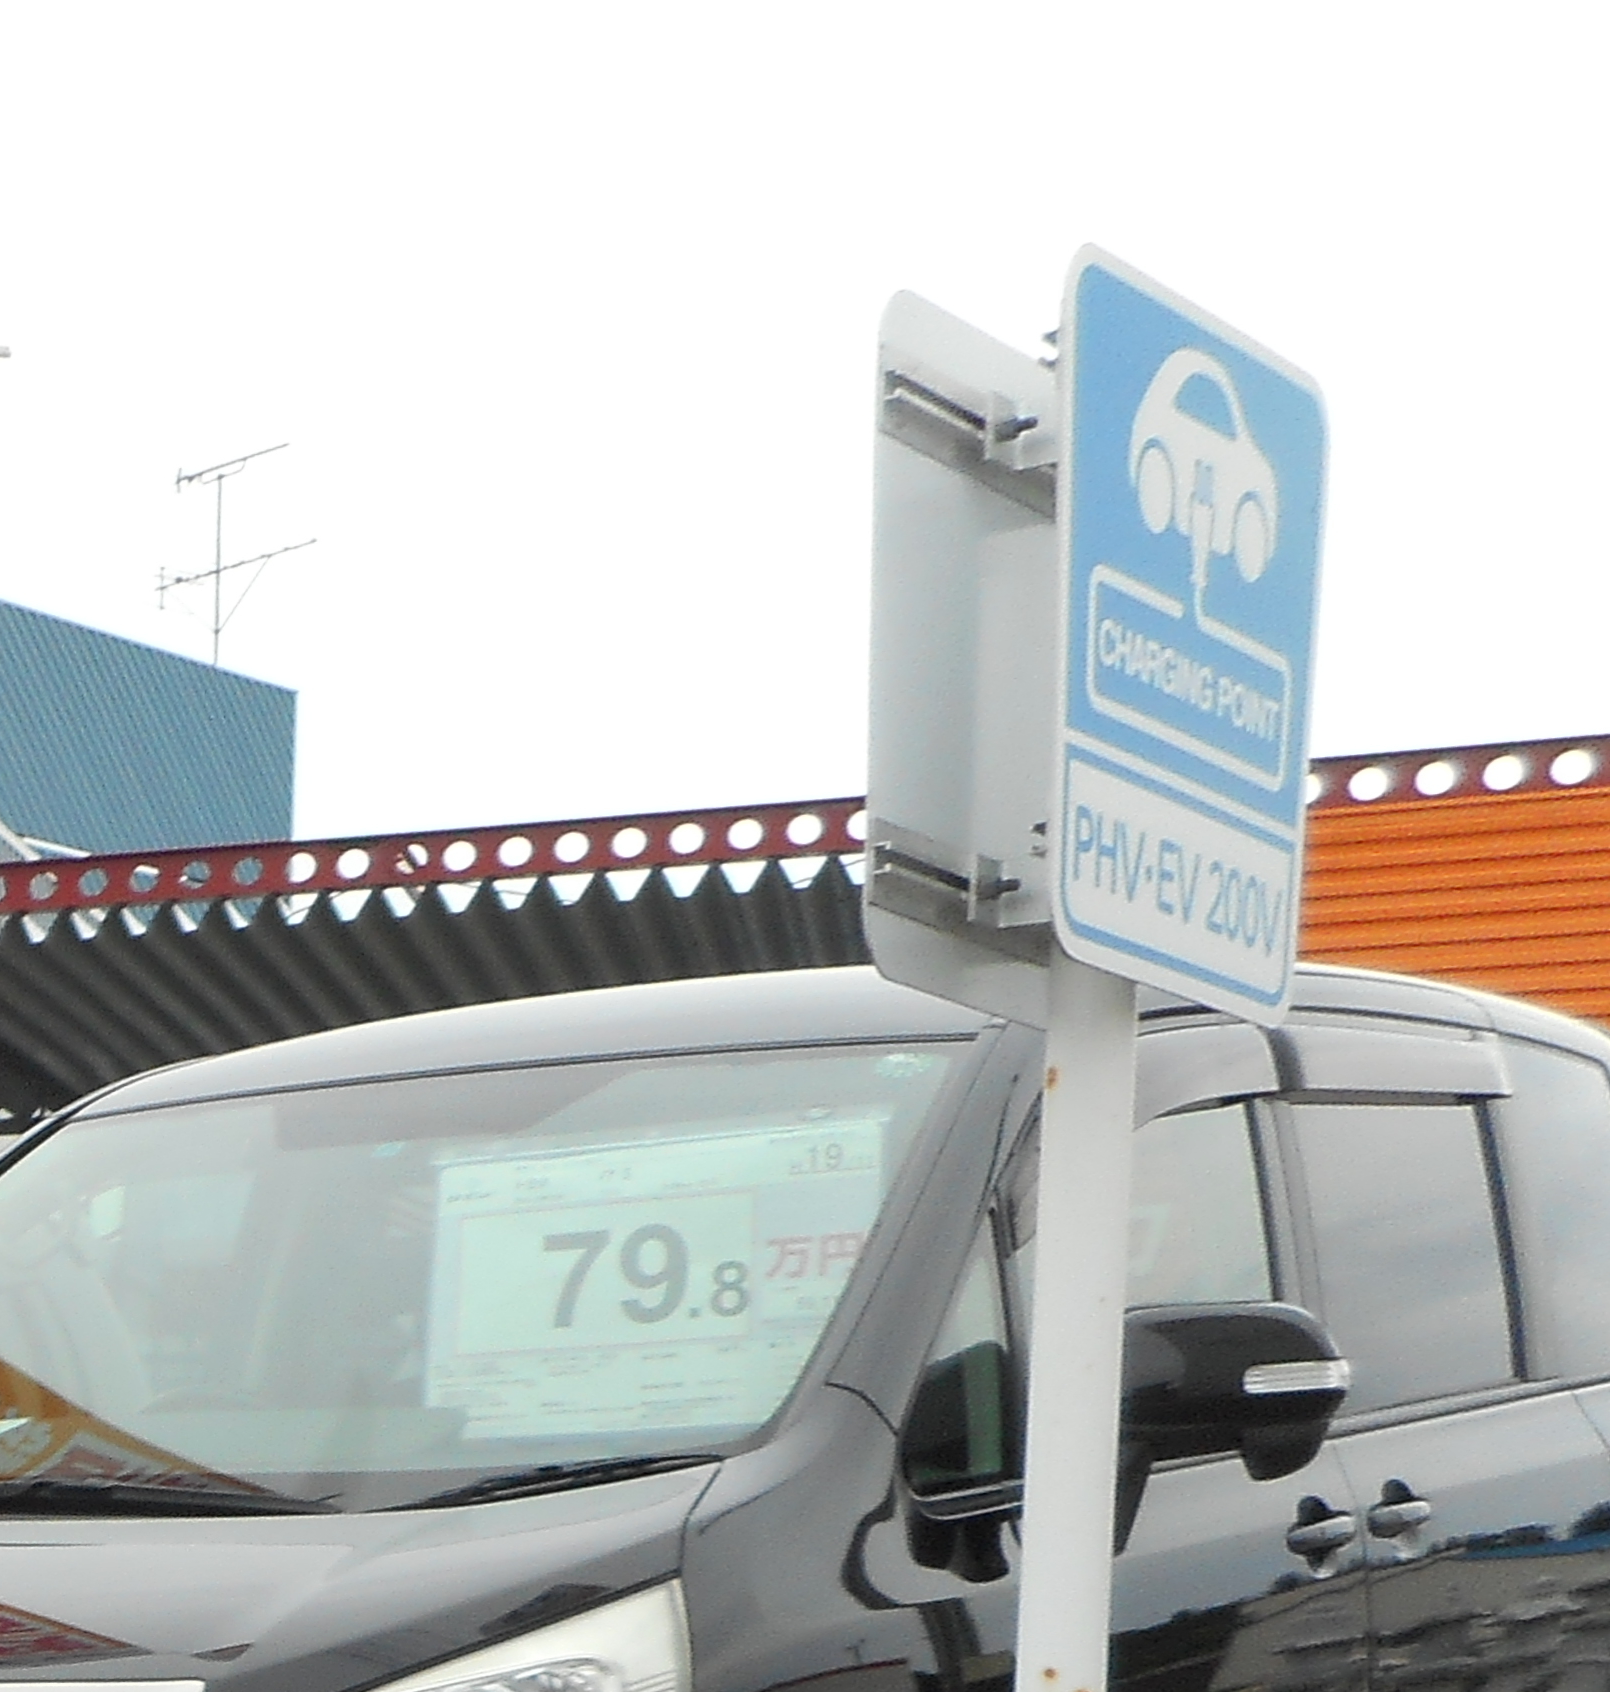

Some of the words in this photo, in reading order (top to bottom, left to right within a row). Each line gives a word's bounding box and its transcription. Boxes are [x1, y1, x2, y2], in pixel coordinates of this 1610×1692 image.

[1099, 617, 1213, 714] CHARGING
[1216, 673, 1281, 743] POINT
[1204, 859, 1283, 957] 200V
[542, 1223, 753, 1330] 79.8
